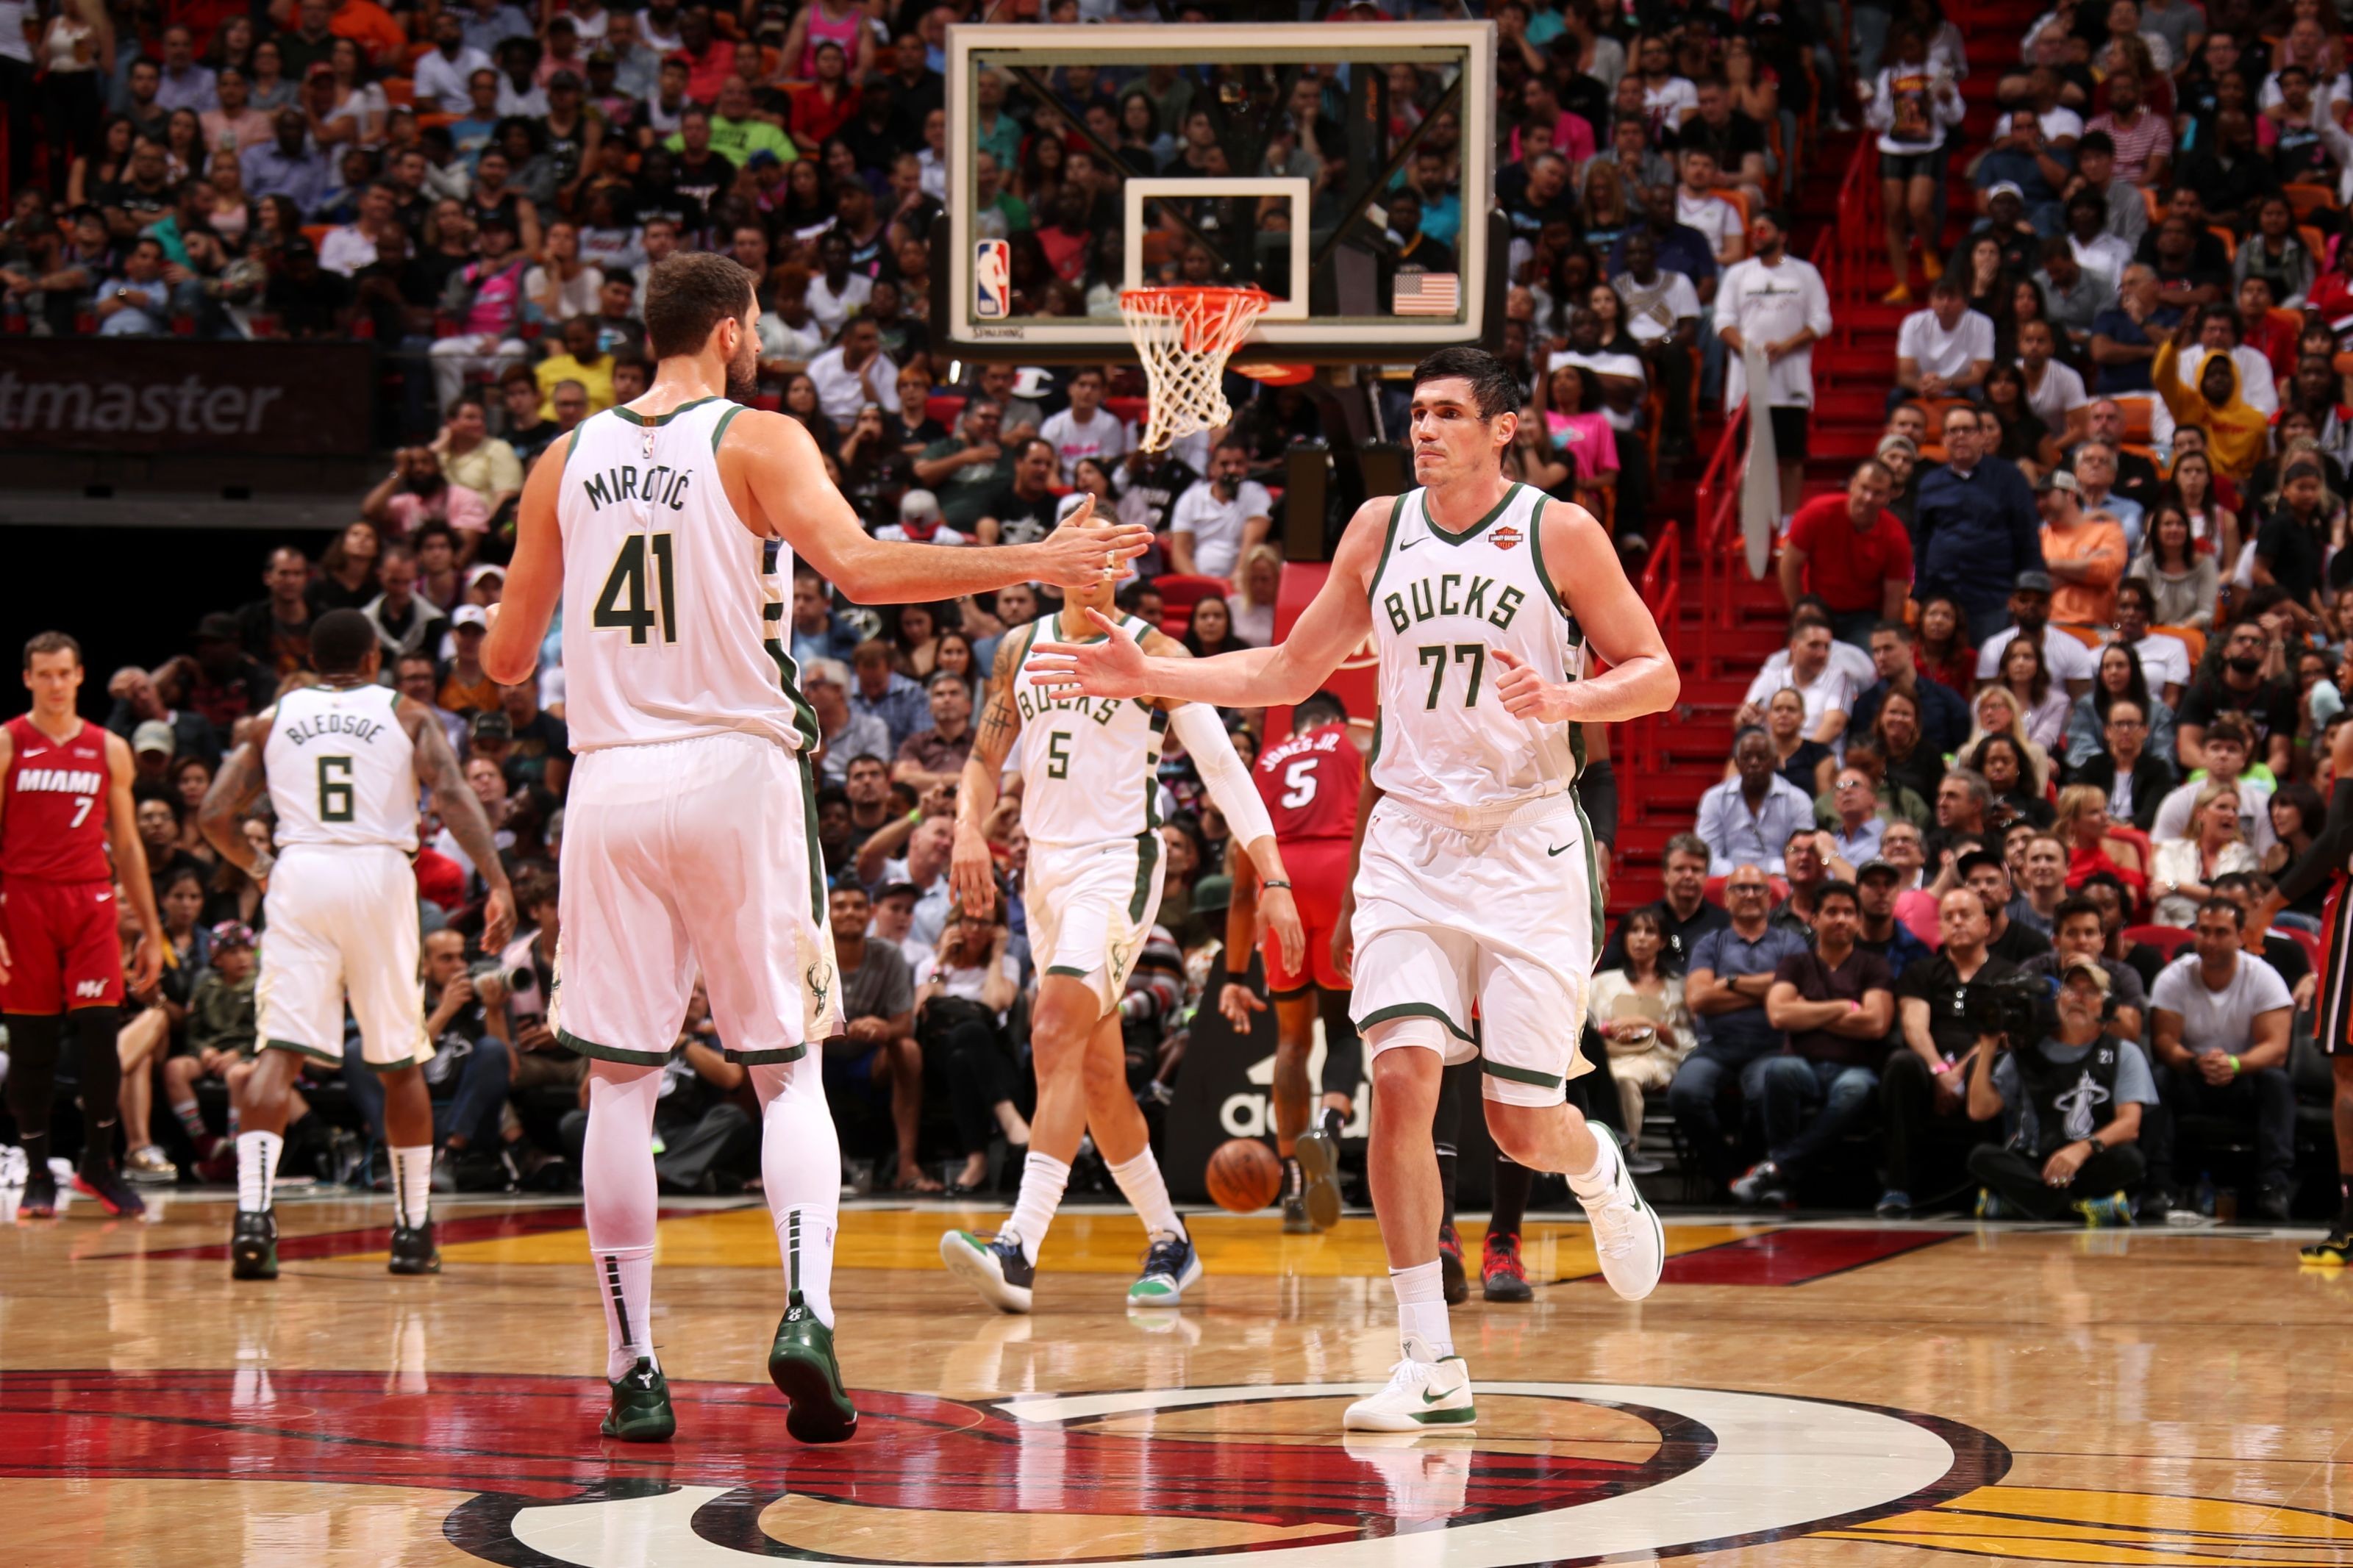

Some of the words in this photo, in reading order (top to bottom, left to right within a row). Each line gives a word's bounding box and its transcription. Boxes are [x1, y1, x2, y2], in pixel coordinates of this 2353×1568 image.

[583, 465, 693, 512] MIROTIĆ
[591, 531, 678, 646] 41
[1383, 573, 1526, 636] BUCKS
[1417, 642, 1485, 711] 77
[285, 714, 387, 746] BLEDSOE
[1048, 731, 1072, 780] 5
[1260, 737, 1313, 773] JONES
[16, 768, 101, 795] MIAMI
[317, 755, 355, 823] 6
[1281, 757, 1319, 809] 5
[70, 796, 94, 828] 7
